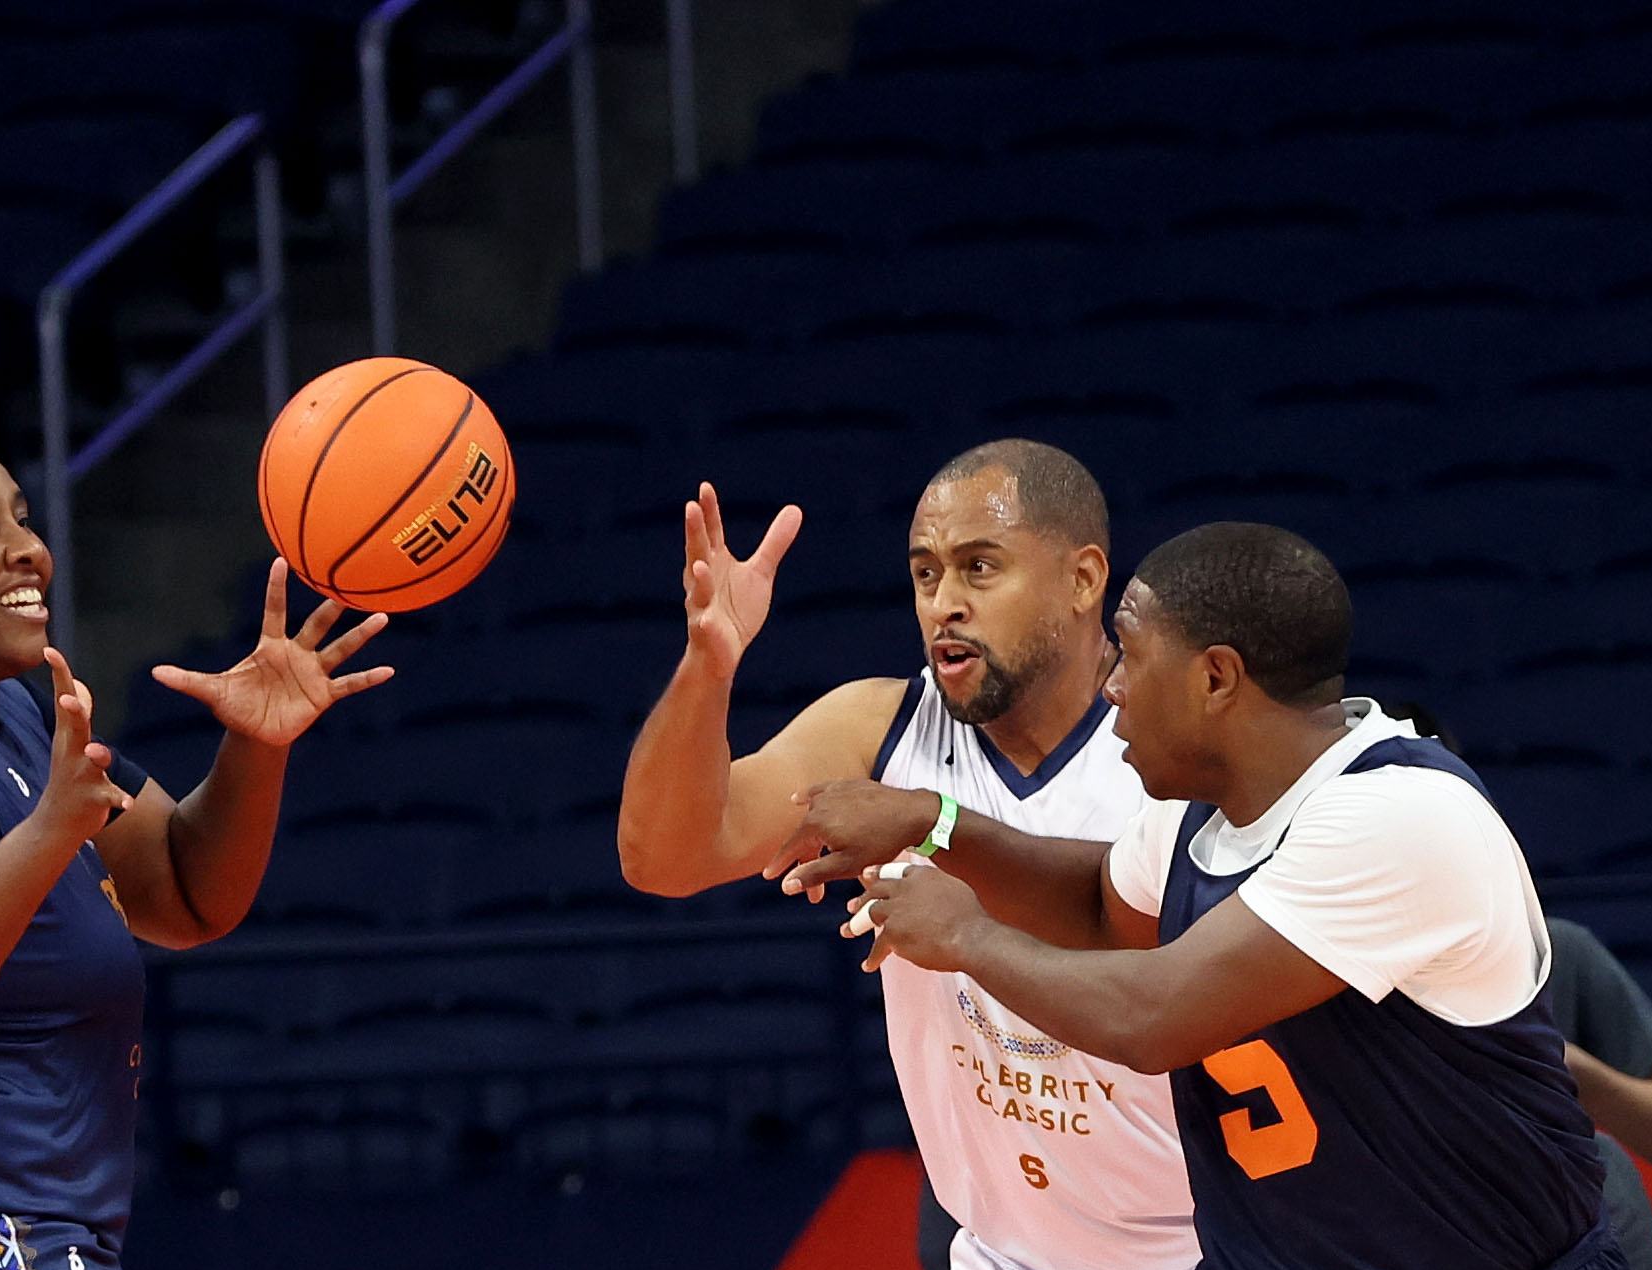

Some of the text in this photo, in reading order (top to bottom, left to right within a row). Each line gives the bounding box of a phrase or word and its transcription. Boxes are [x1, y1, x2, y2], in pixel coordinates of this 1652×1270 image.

[400, 451, 498, 567] ELITE
[952, 1044, 1115, 1103] CLEBRITY
[1018, 1153, 1050, 1190] S
